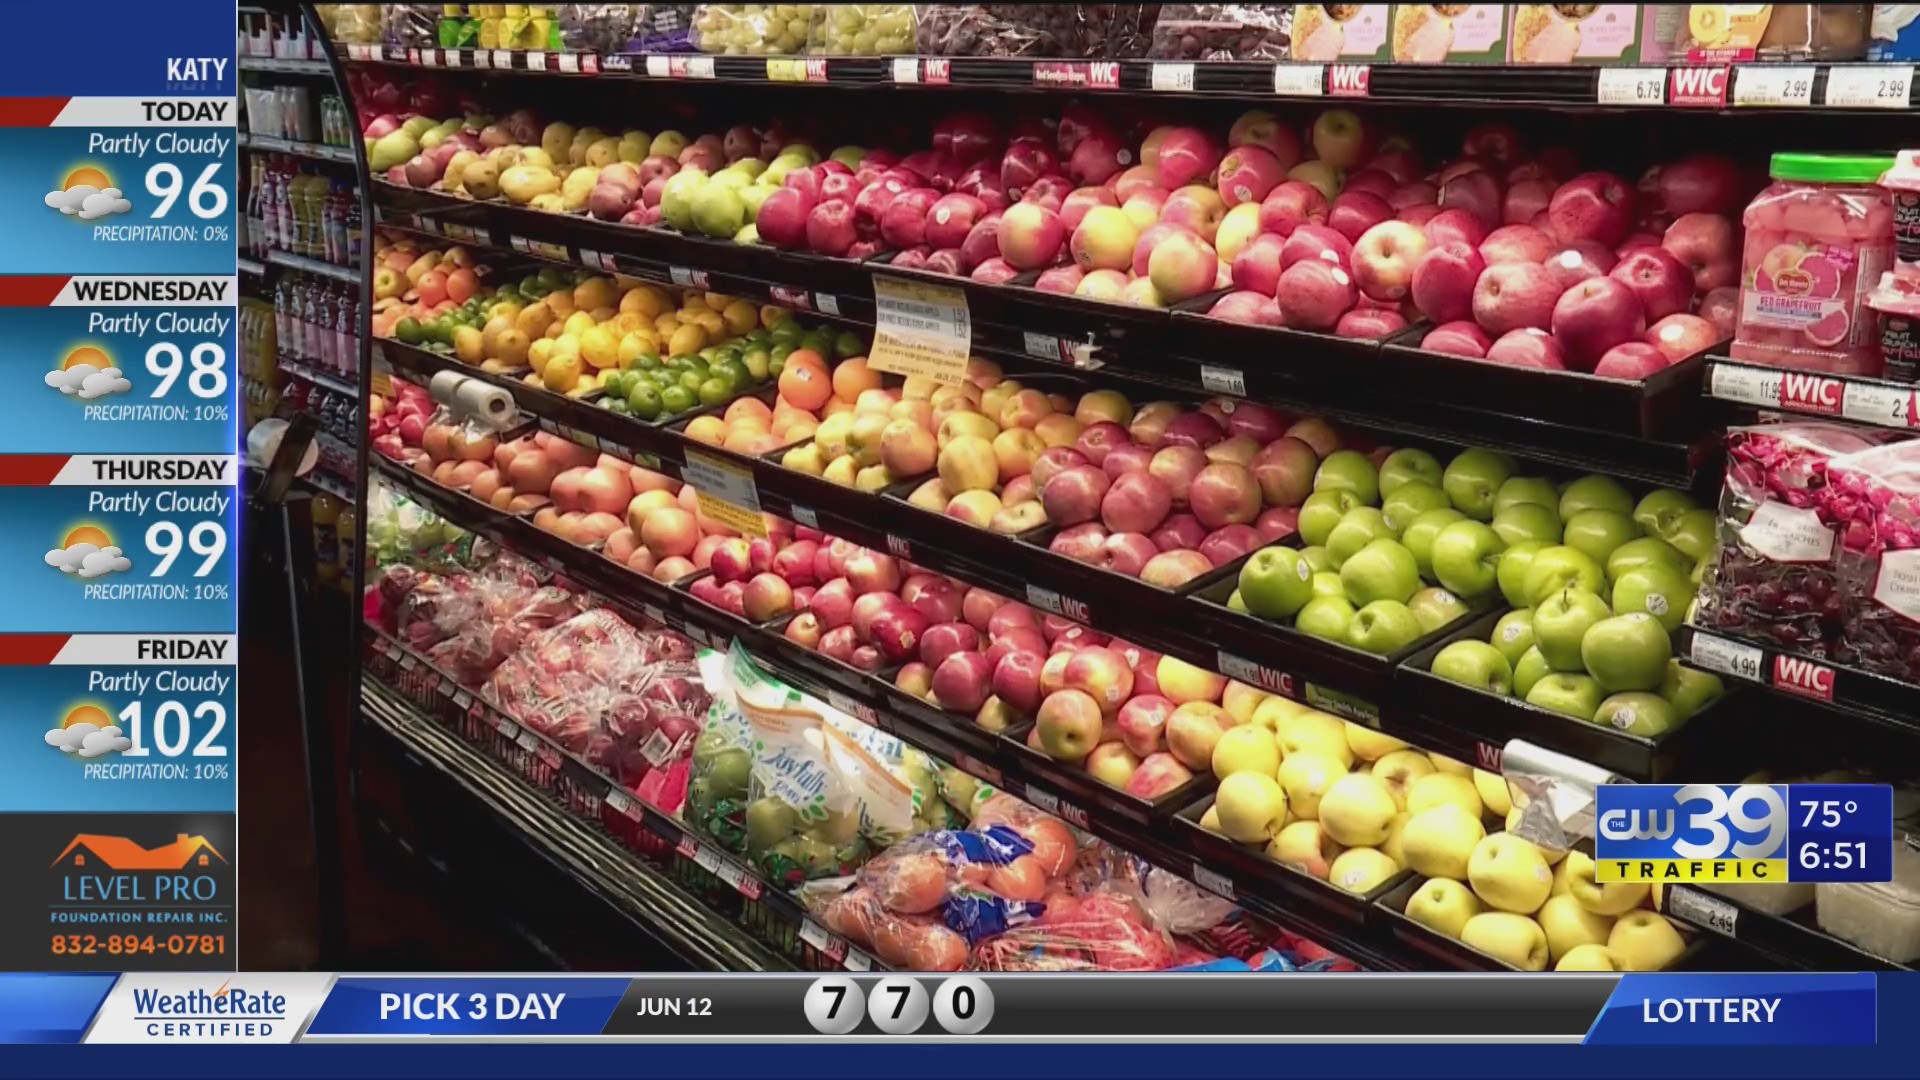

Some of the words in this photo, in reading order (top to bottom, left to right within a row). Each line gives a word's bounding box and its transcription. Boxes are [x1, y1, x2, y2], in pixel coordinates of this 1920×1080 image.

[926, 60, 948, 76] WIC
[1090, 62, 1118, 83] WIC
[1332, 66, 1367, 90] WIC
[1635, 80, 1662, 100] 6.79
[1675, 67, 1726, 97] WIC
[1783, 80, 1808, 97] 2.99
[1877, 80, 1904, 97] 2.99
[1775, 297, 1822, 312] GRAPEFRUIT
[1785, 372, 1840, 406] WIC
[1061, 595, 1088, 619] WIC
[1730, 654, 1757, 677] 4.99
[1779, 655, 1831, 692] WIC
[1260, 665, 1293, 692] WIC
[1709, 910, 1733, 933] 2.49
